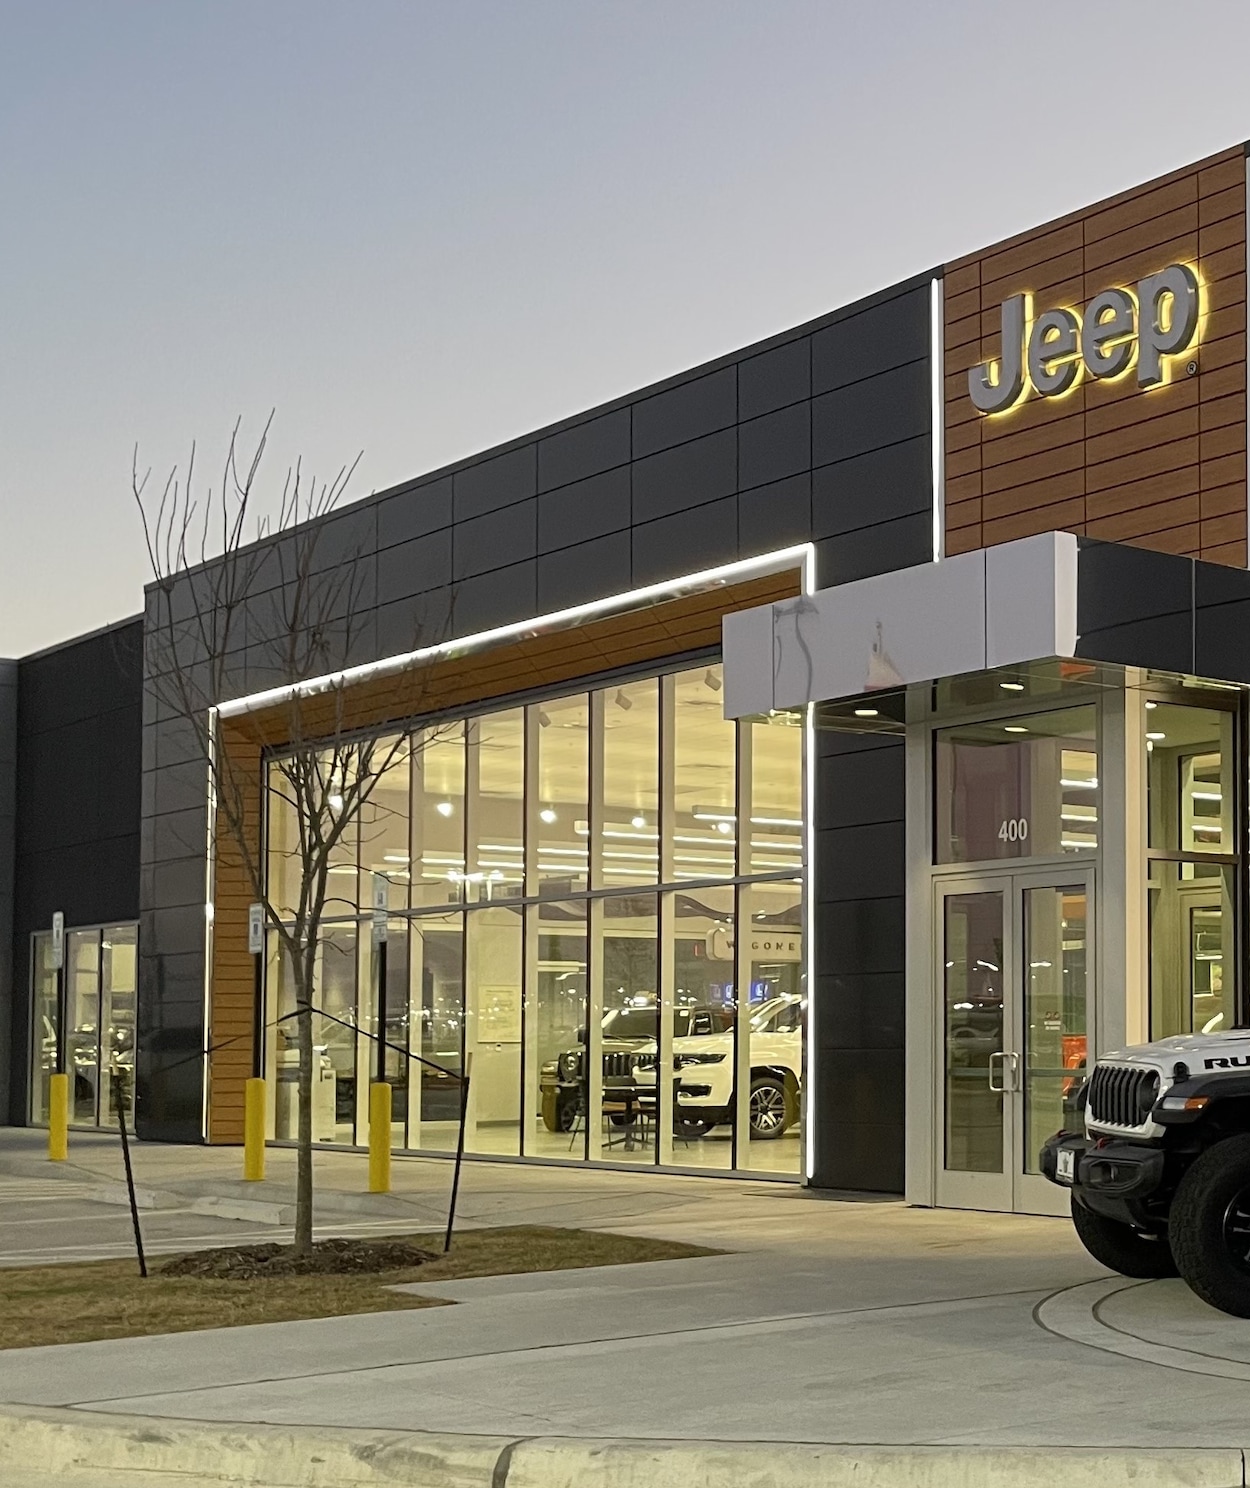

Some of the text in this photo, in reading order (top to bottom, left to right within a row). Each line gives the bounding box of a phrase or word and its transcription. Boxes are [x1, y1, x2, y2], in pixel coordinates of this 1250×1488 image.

[967, 263, 1200, 414] Jeep
[998, 818, 1028, 842] 400
[726, 940, 795, 951] WGONE
